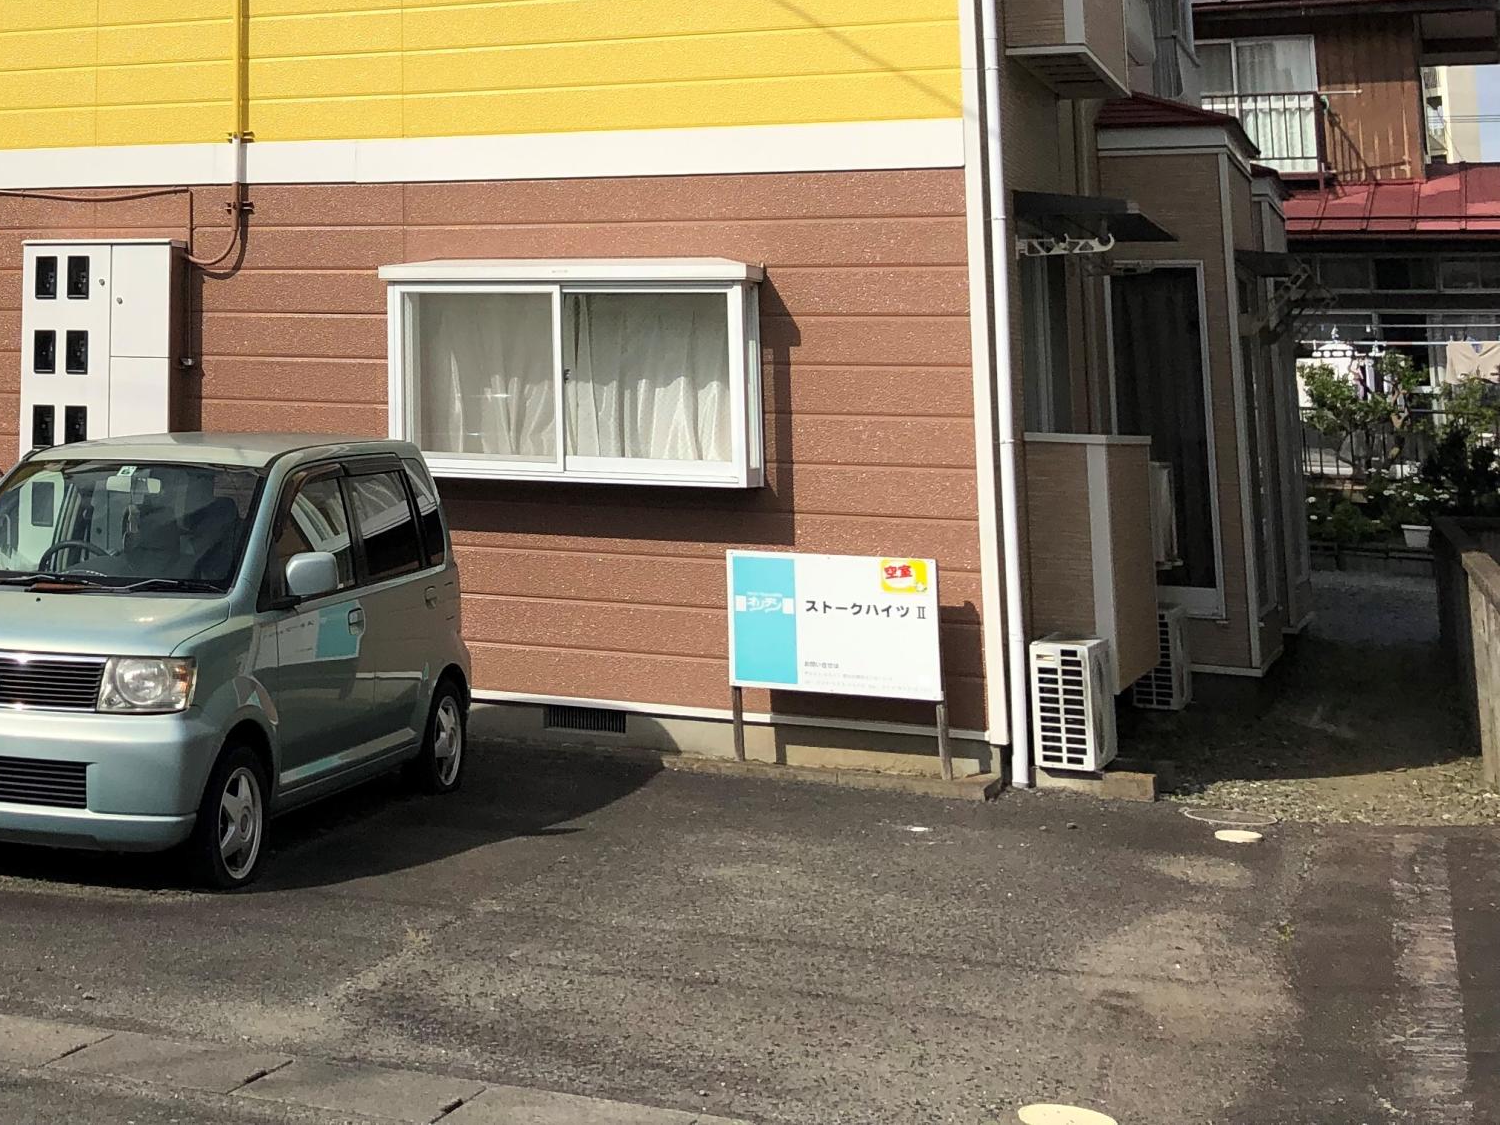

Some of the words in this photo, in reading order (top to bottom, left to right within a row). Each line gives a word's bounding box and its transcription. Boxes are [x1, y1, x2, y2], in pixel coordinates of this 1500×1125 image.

[805, 600, 910, 618] ストークハイツ
